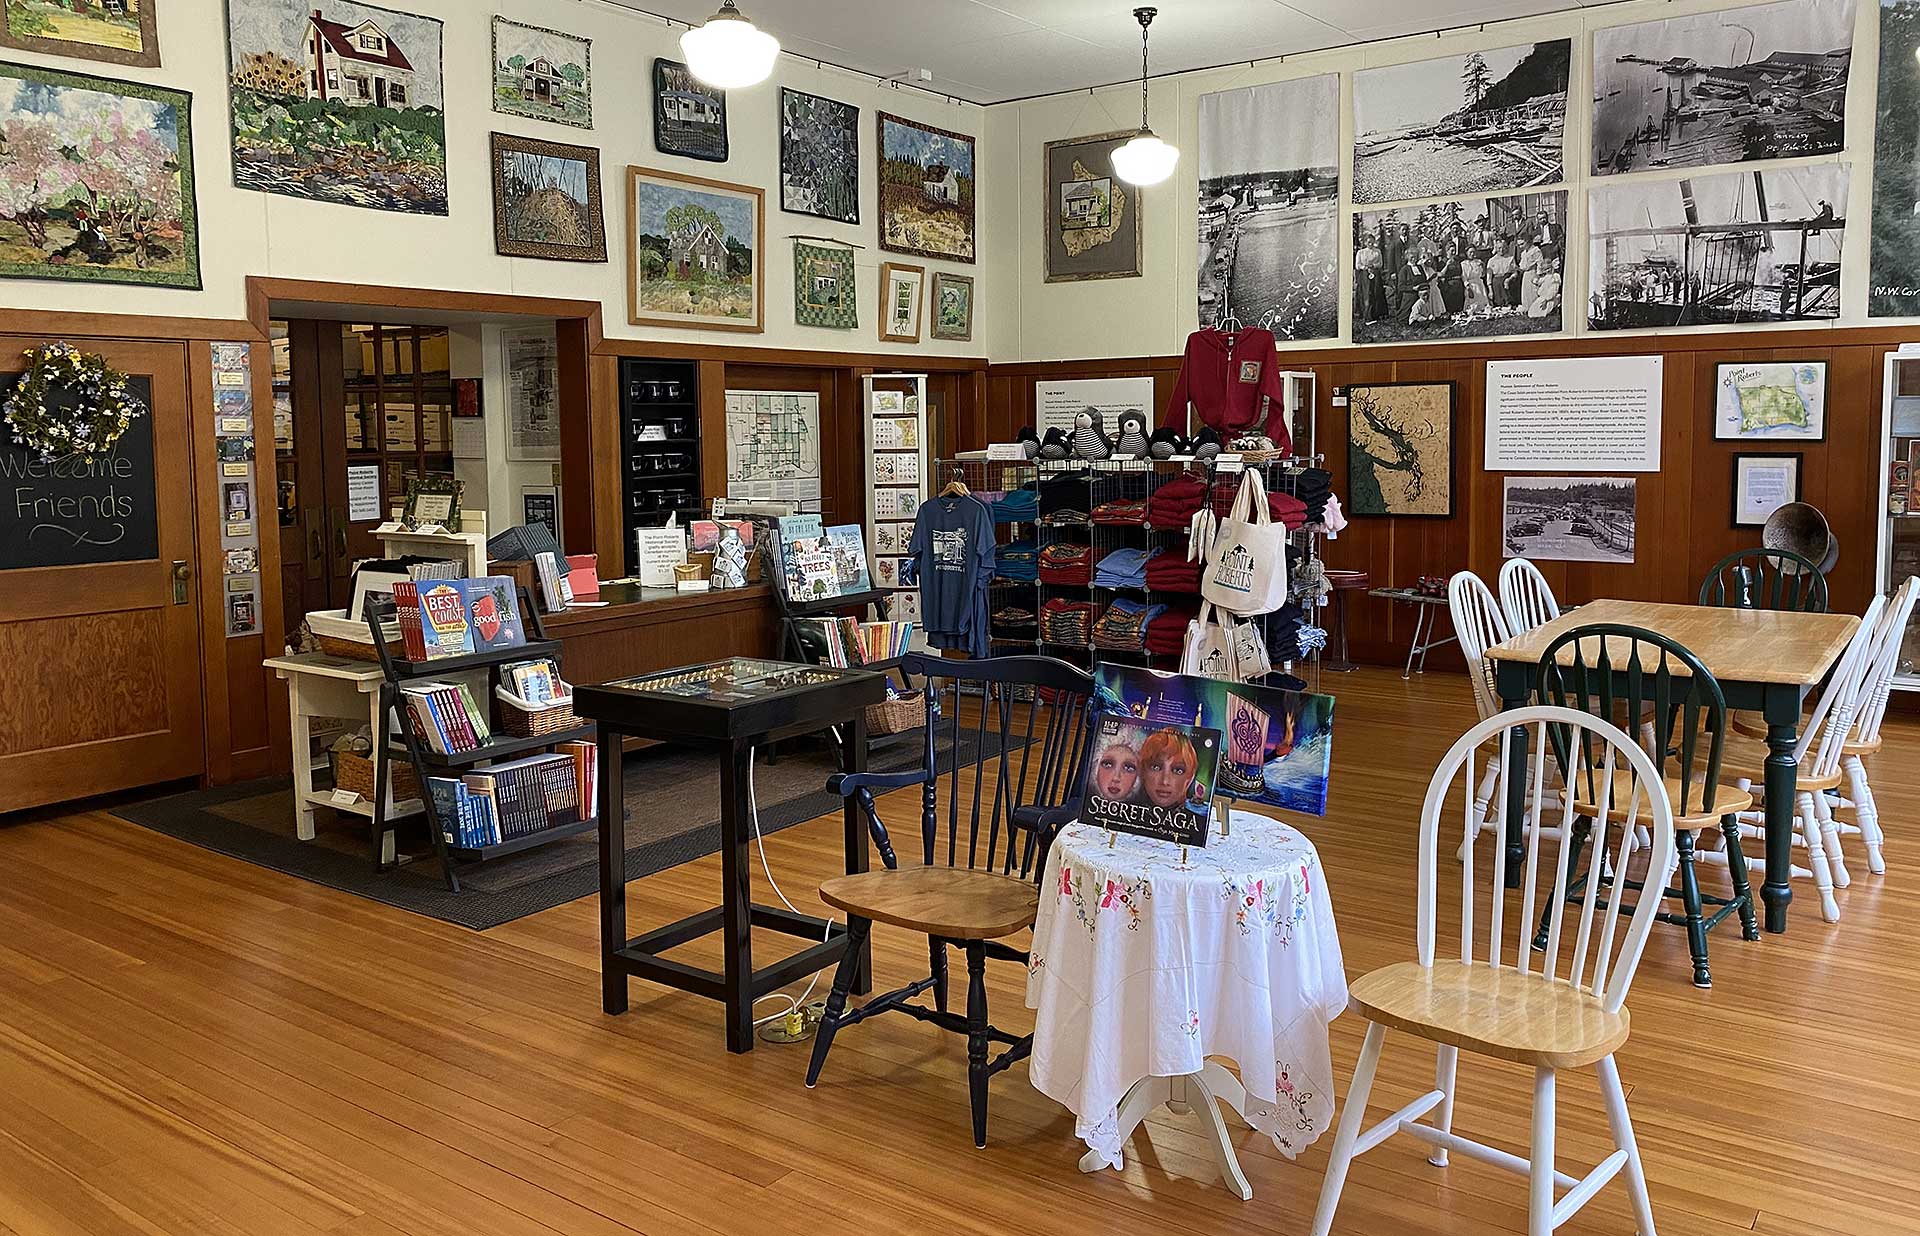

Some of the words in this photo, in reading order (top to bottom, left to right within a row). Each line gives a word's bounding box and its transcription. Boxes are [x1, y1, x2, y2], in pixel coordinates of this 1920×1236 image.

[1874, 286, 1899, 297] N.W.
[1728, 367, 1746, 379] Point
[1737, 370, 1763, 383] Roberts
[0, 452, 133, 480] Welcome
[15, 485, 133, 519] Friends
[802, 560, 831, 573] TREES
[1224, 550, 1249, 570] POINT
[1215, 565, 1253, 589] ROBERTS
[428, 595, 458, 611] BEST
[434, 602, 465, 624] coast
[473, 611, 497, 628] good
[498, 609, 517, 623] fish
[1203, 657, 1228, 672] POINT
[1088, 795, 1150, 822] SECRET
[1150, 806, 1199, 832] SAGA
